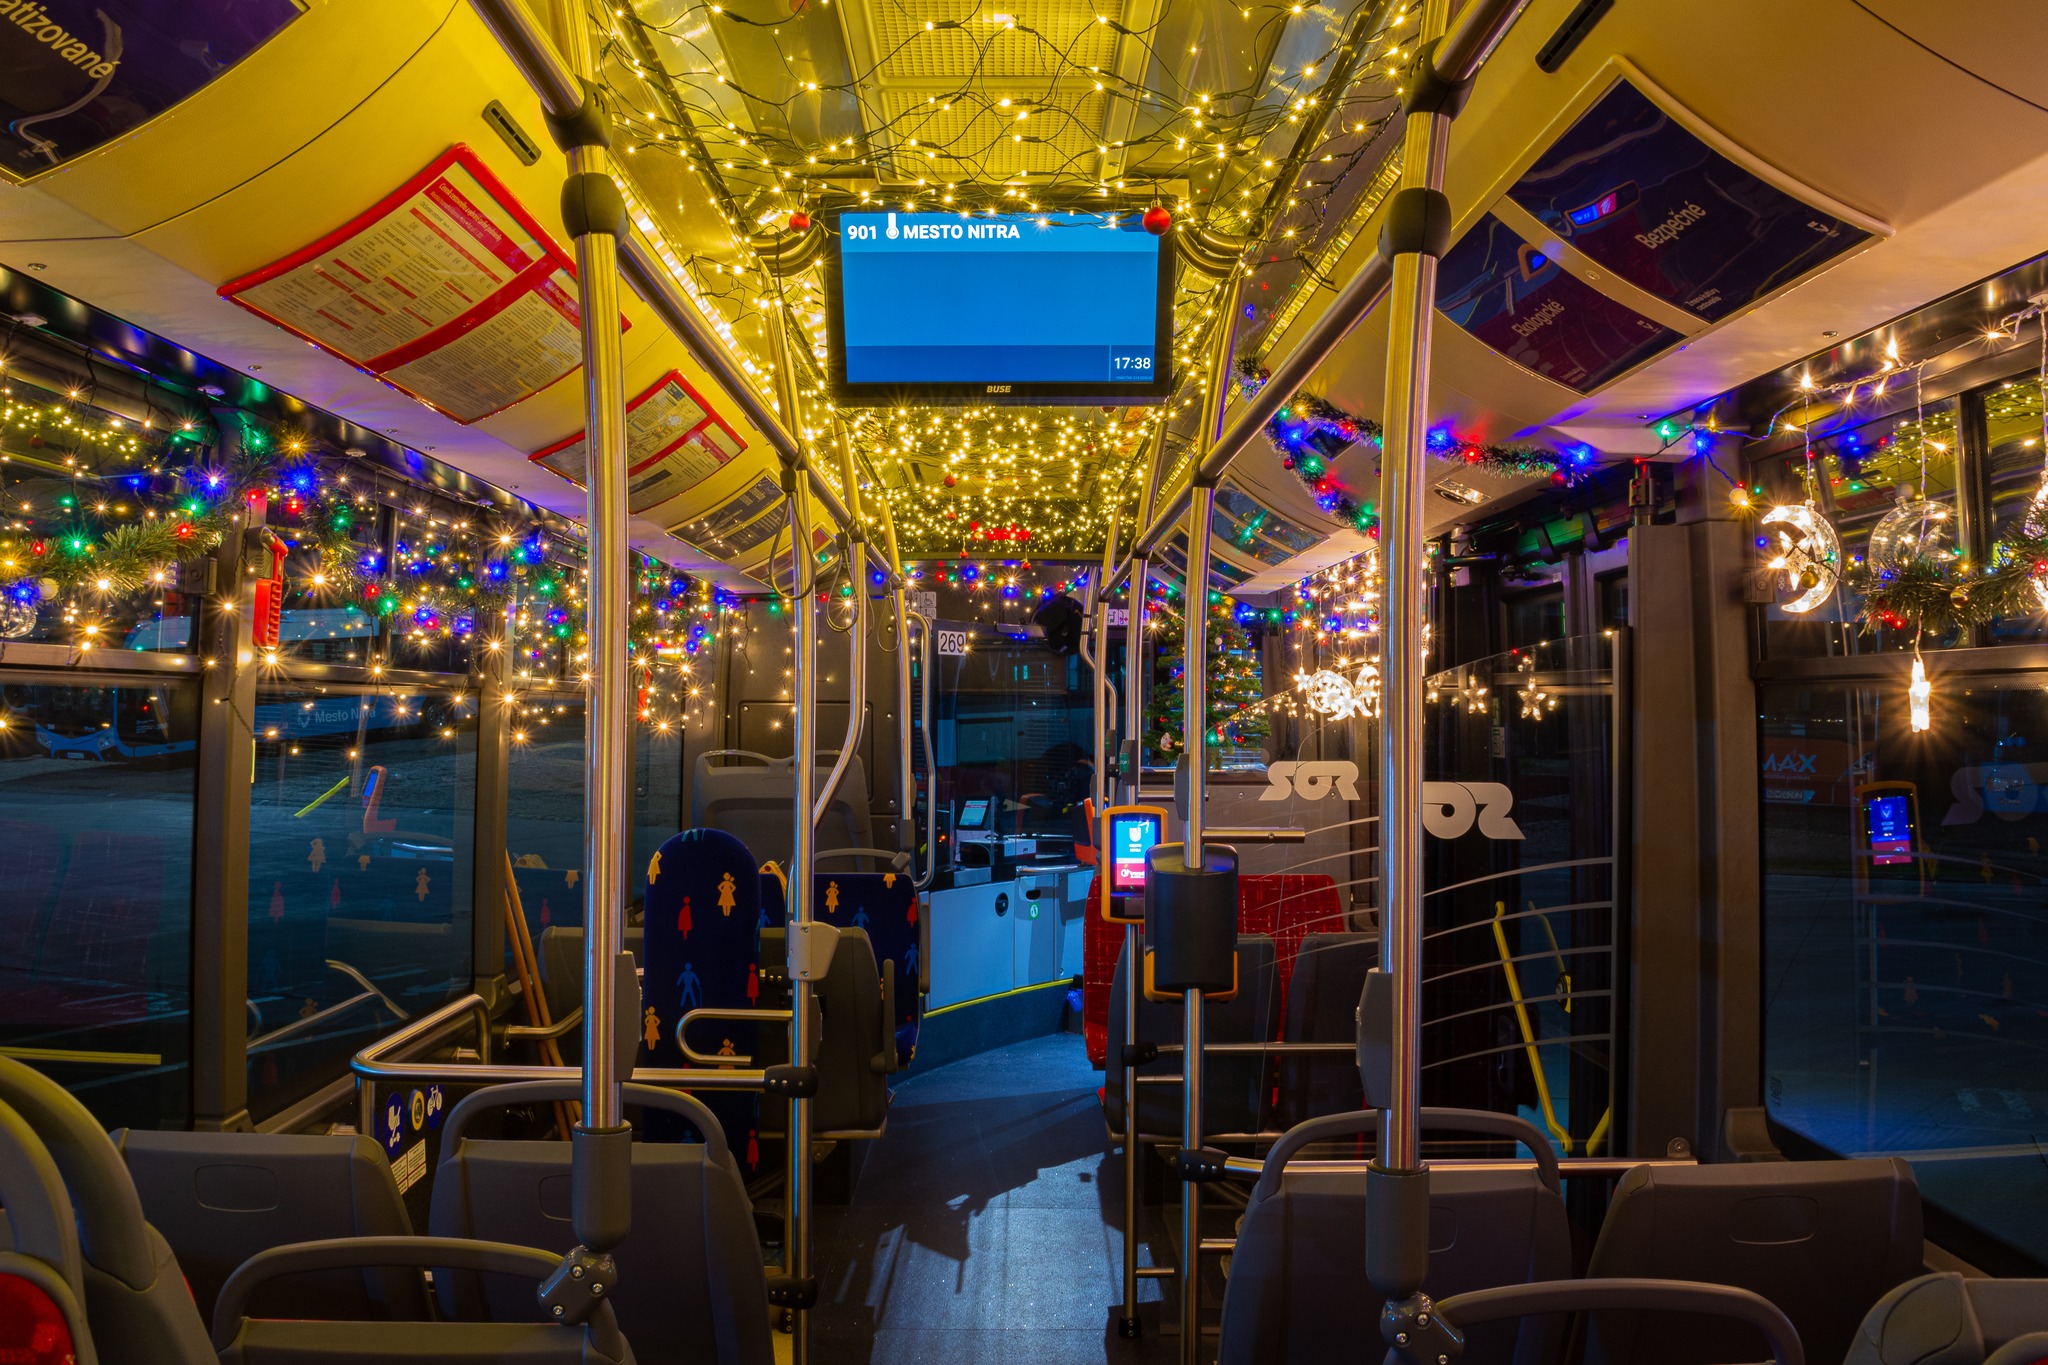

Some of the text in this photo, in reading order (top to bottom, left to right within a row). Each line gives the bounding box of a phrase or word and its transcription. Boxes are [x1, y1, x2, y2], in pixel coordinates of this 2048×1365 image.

[847, 225, 876, 240] 901
[903, 225, 1020, 239] MESTO NITRA
[1635, 200, 1707, 250] Bezpečné
[1512, 298, 1566, 338] Ekologické
[1114, 357, 1151, 370] 17:38
[986, 385, 1012, 393] BUSE
[940, 633, 965, 653] 269
[315, 709, 348, 724] Mesto
